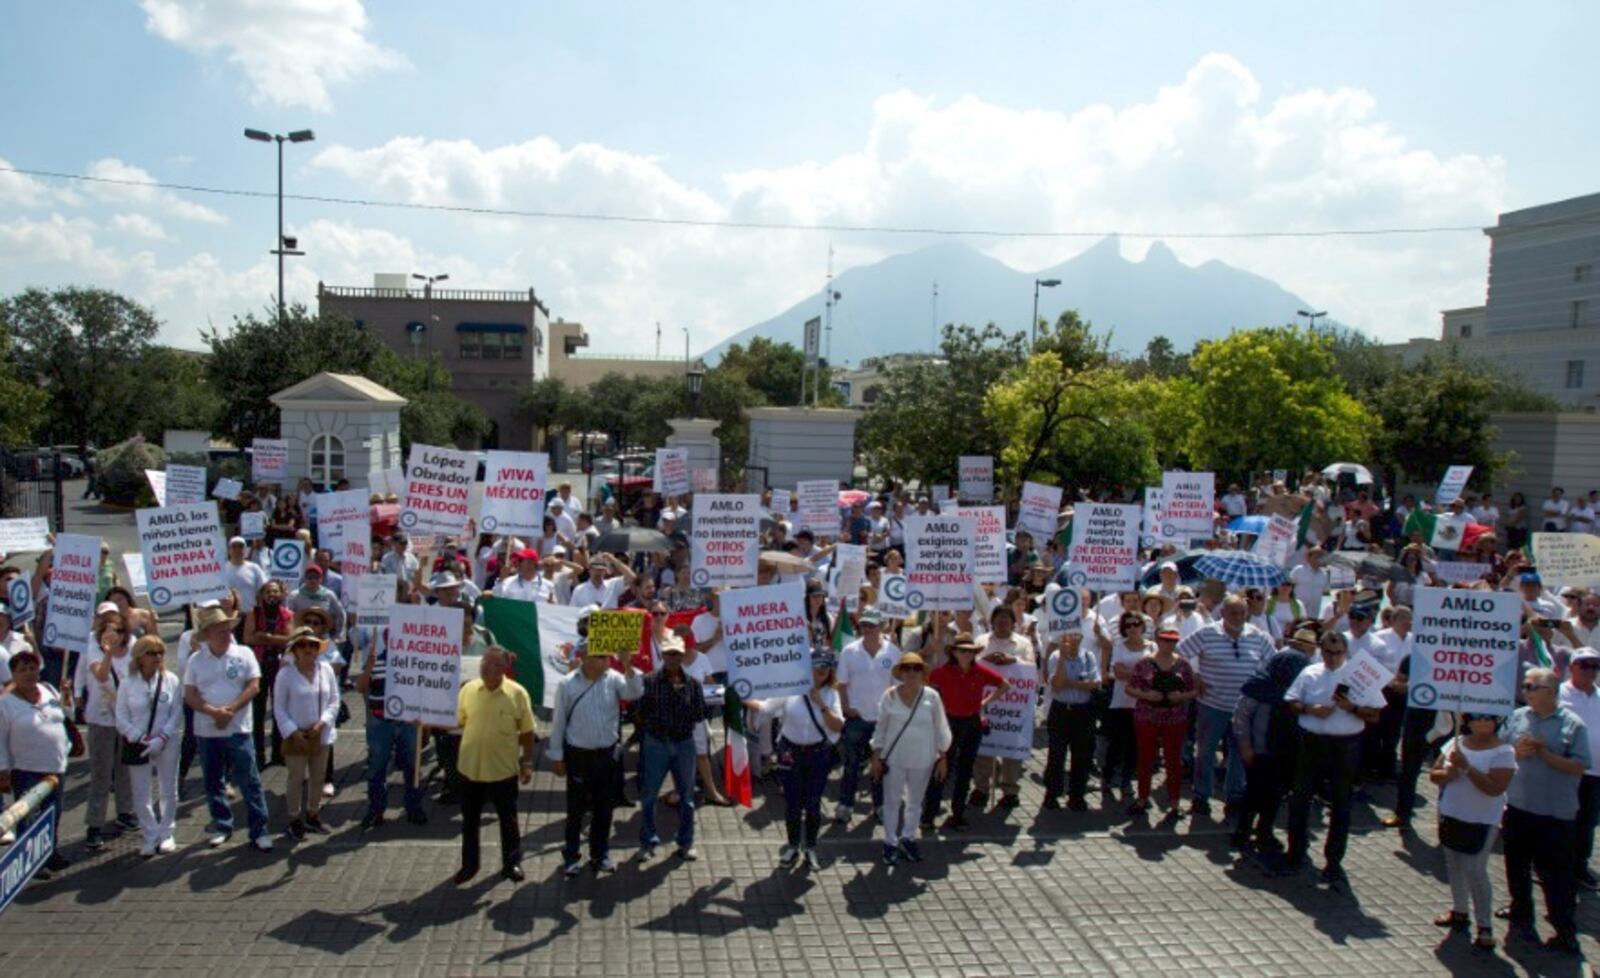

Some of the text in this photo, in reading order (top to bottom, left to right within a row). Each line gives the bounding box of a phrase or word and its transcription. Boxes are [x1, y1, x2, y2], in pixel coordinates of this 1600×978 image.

[424, 453, 465, 469] López
[412, 467, 470, 485] Obrador
[409, 482, 468, 500] ERES UN
[405, 497, 468, 515] TRAIDOR
[710, 500, 744, 512] AMLO
[1092, 506, 1122, 517] AMLO
[191, 511, 208, 521] los
[698, 515, 755, 525] mentiroso
[1088, 518, 1126, 528] respeta
[142, 524, 218, 541] niños tienen
[694, 529, 757, 539] no inventes
[925, 522, 960, 534] AMLO
[1086, 527, 1124, 537] nuestro
[152, 538, 212, 553] derecho a
[706, 541, 745, 551] OTROS
[918, 535, 968, 550] exigimos
[1085, 537, 1124, 546] derecho
[152, 556, 171, 566] UN
[207, 549, 217, 559] Y
[919, 549, 963, 559] servicio
[1090, 547, 1132, 557] EDUCAR
[81, 556, 92, 567] LA
[706, 555, 744, 566] DATOS
[916, 560, 957, 571] médico
[959, 562, 967, 573] y
[1081, 556, 1134, 566] NUESTROS
[151, 567, 178, 580] UNA
[1087, 566, 1117, 575] HIJOS
[908, 573, 973, 584] MEDICINAS
[53, 585, 92, 602] del pueblo
[738, 602, 789, 618] MUERA
[1441, 597, 1495, 612] AMLO
[590, 612, 642, 628] BRONCO
[725, 615, 805, 636] LA AGENDA
[1422, 614, 1512, 632] mentiroso
[402, 622, 447, 638] MUERA
[389, 639, 461, 656] LA AGENDA
[730, 631, 804, 651] del Foro de
[1415, 632, 1516, 650] no inventes
[391, 655, 457, 673] del Foro de
[735, 649, 802, 668] Sao Paulo
[1433, 650, 1495, 667] OTROS
[393, 673, 452, 690] Sao Paulo
[1432, 668, 1493, 685] DATOS
[984, 704, 1021, 719] López
